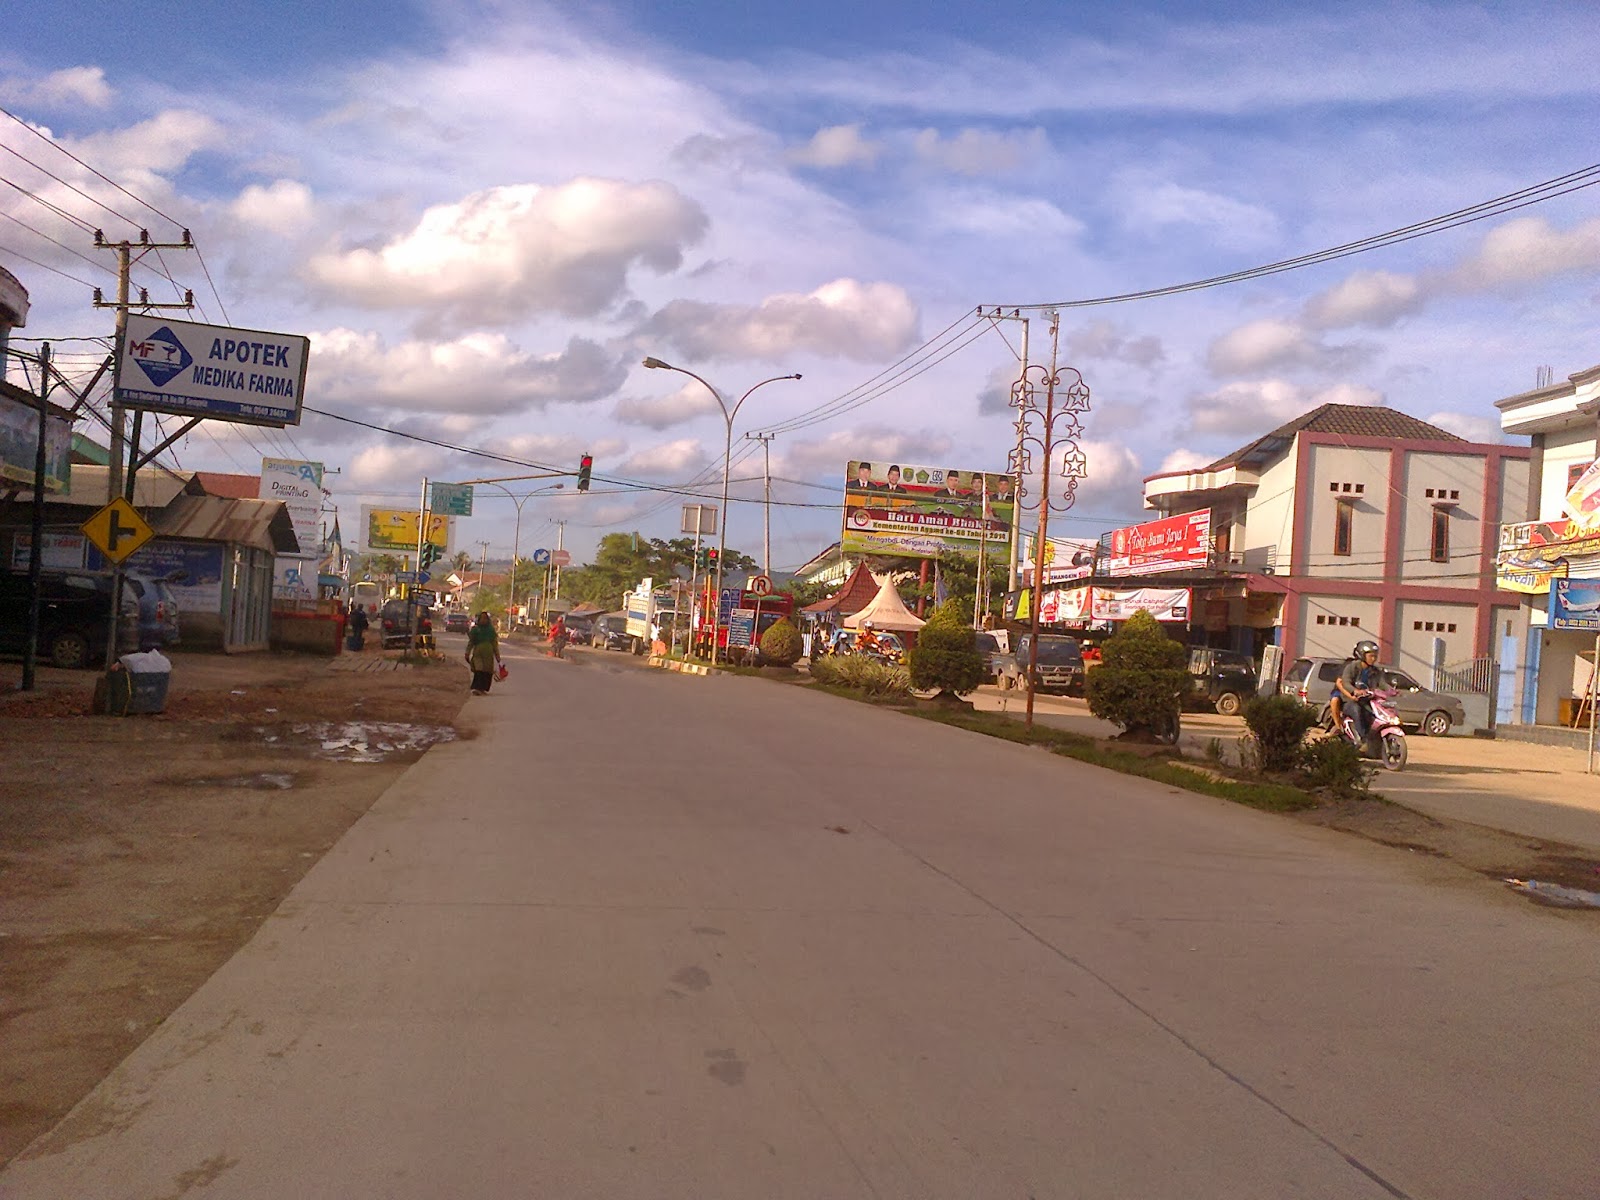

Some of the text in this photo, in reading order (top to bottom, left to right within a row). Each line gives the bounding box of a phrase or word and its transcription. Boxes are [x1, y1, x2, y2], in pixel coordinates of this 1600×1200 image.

[128, 340, 155, 358] MF
[208, 337, 291, 368] APOTEK
[192, 365, 294, 398] MEDIKA FARMA
[271, 481, 299, 492] DIGITAL
[275, 489, 309, 498] PRINTING
[287, 505, 317, 513] dvertising
[872, 521, 919, 532] Kementerian
[920, 526, 944, 535] Agama
[887, 511, 992, 530] Hari Amal Bhaki
